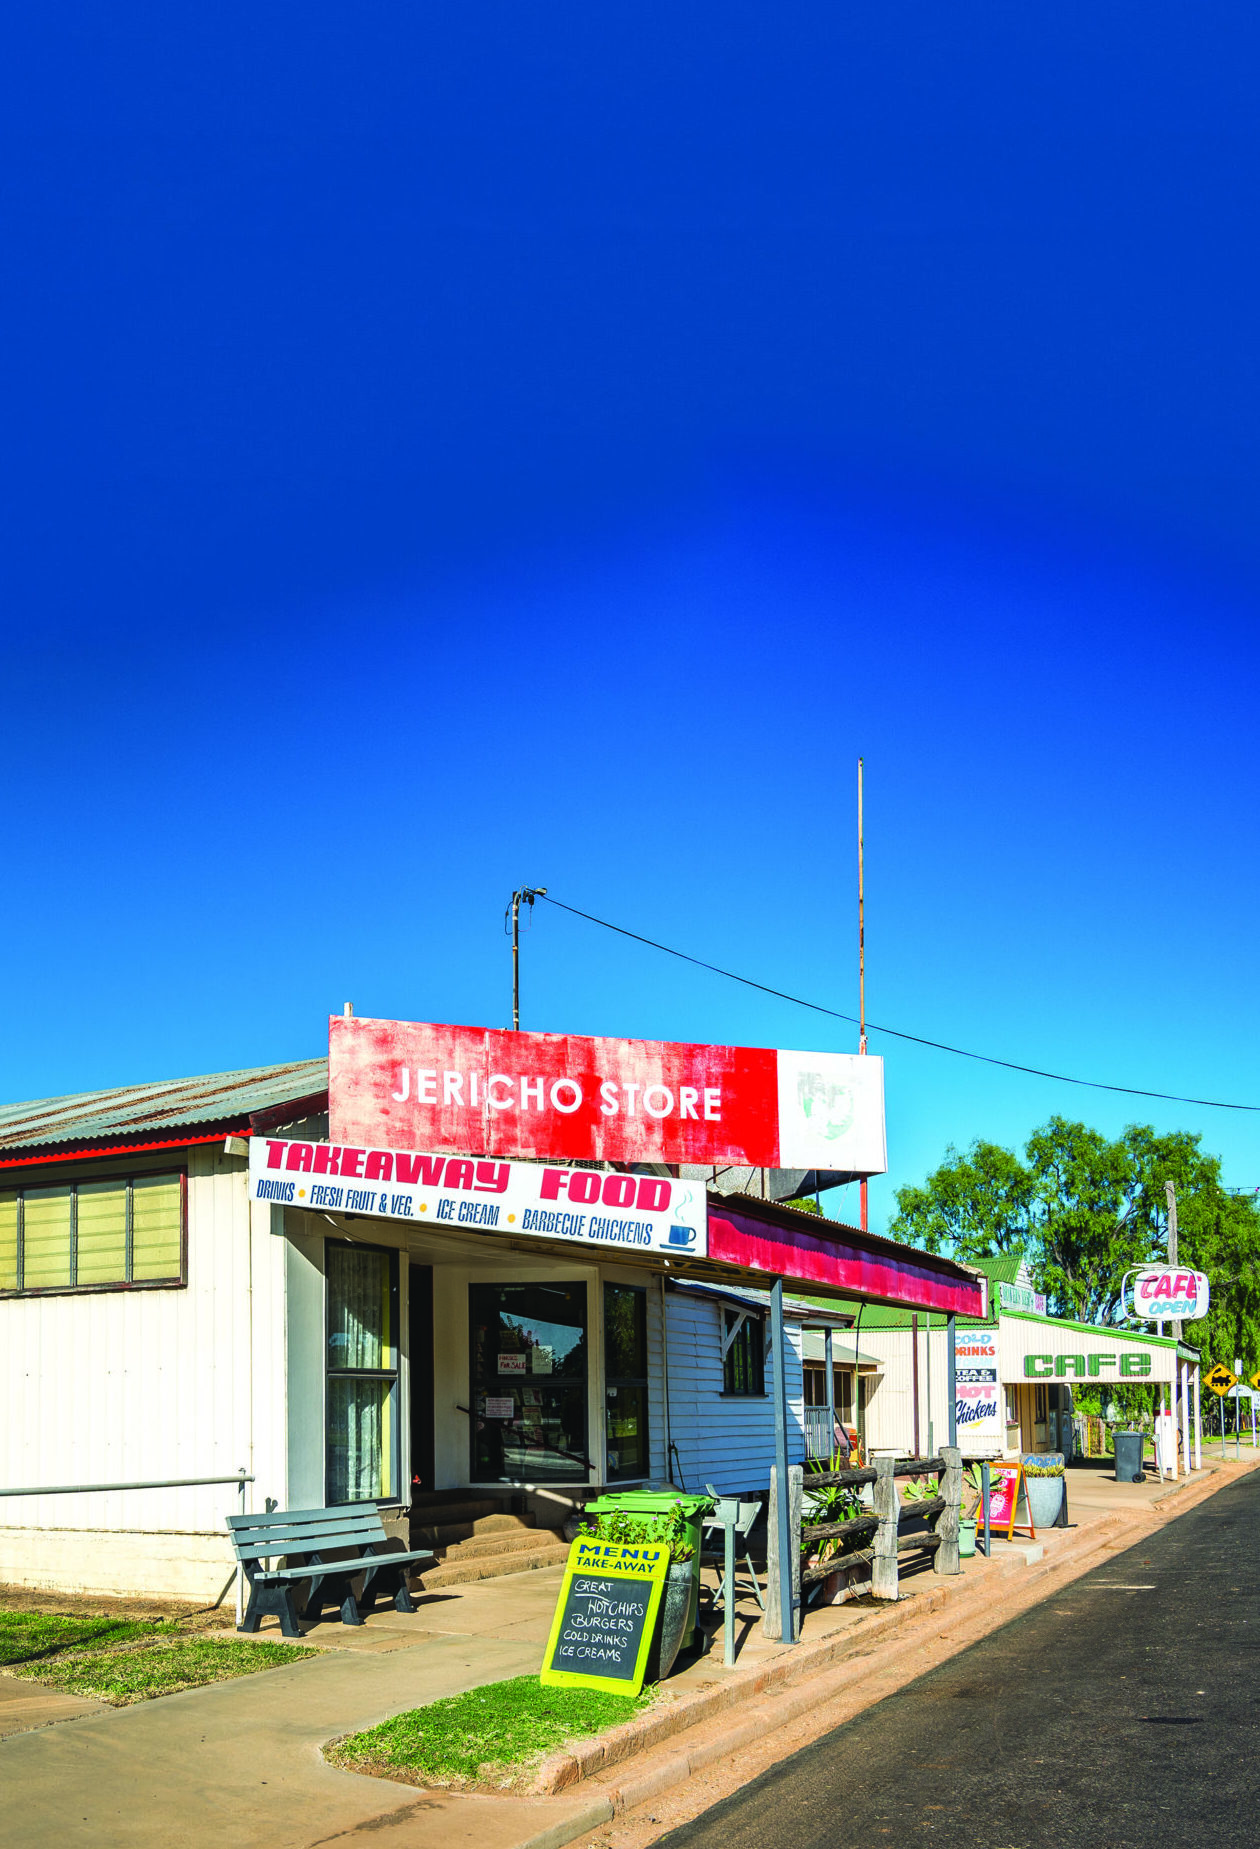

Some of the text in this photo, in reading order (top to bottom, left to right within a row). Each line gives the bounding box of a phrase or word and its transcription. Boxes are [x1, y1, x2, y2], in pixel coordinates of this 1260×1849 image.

[391, 1067, 722, 1121] JERICHO STORE
[266, 1140, 672, 1212] TAKEAWAY FOOD
[256, 1179, 653, 1246] DRINKS FRESH FRUIT & VEG. ICE CREAM BARBECUE CHICKENS
[1140, 1274, 1202, 1299] CAFE
[1149, 1300, 1197, 1315] OPEN
[955, 1333, 992, 1345] COLD
[1024, 1353, 1152, 1378] CAFE
[955, 1385, 996, 1399] HOT
[579, 1544, 661, 1561] MENU
[577, 1556, 656, 1573] TAKE-AWAY
[574, 1579, 614, 1593] GREAT
[571, 1613, 634, 1632] BURGERS
[563, 1629, 628, 1648] COLD DRINKS
[559, 1645, 621, 1662] ICE CREAMS
